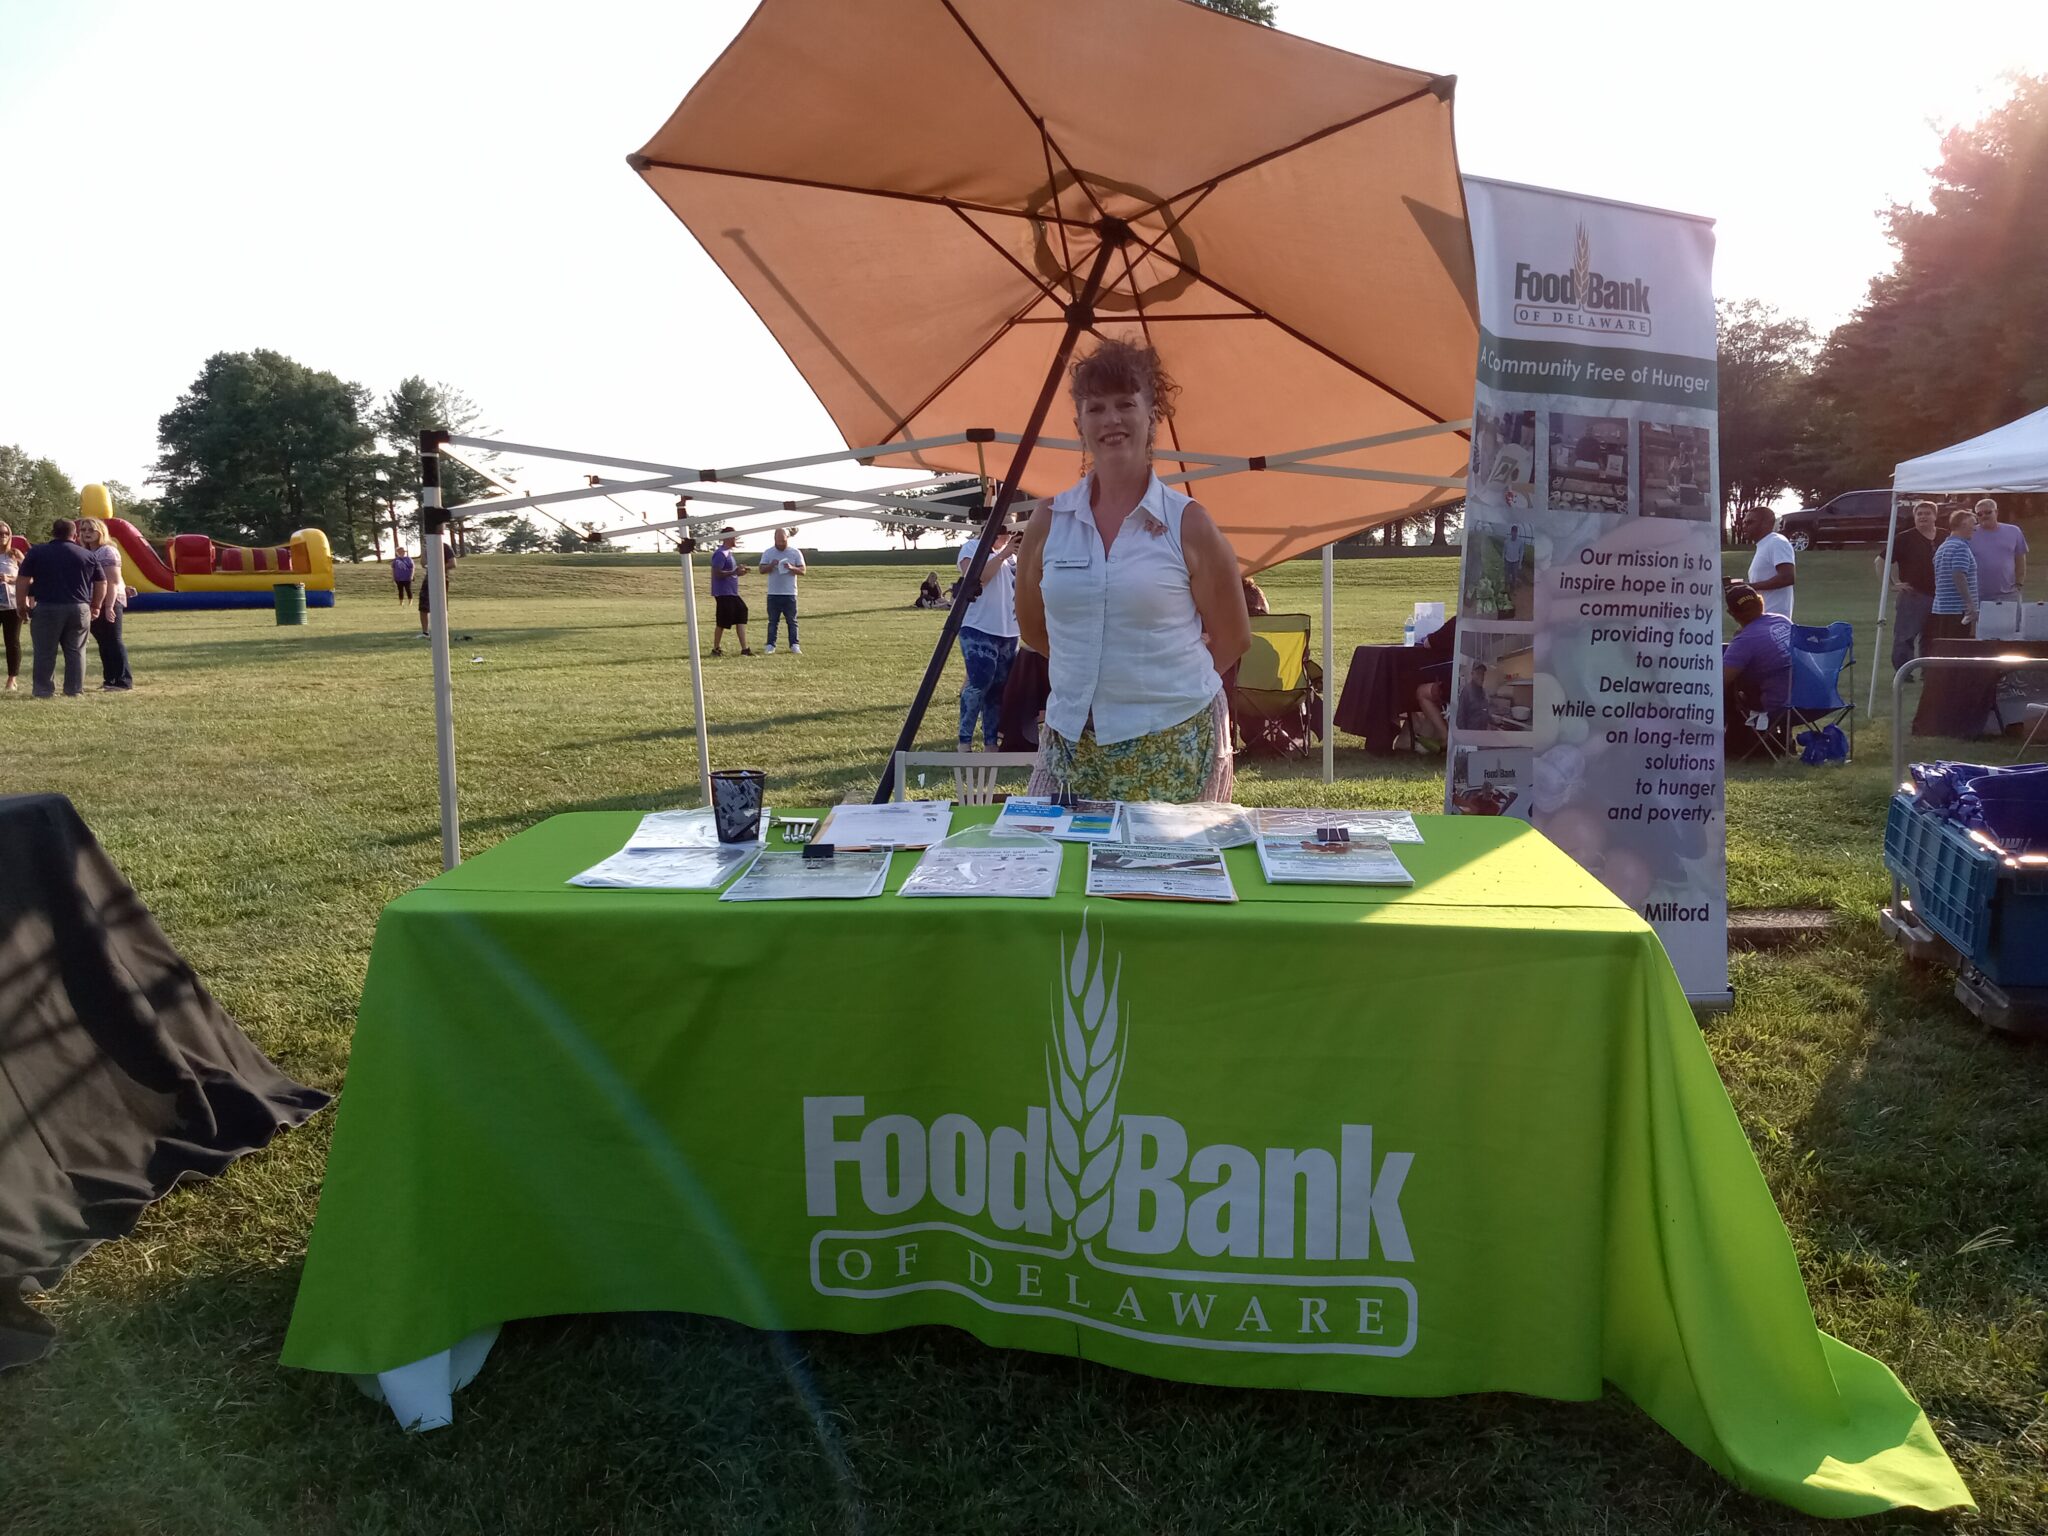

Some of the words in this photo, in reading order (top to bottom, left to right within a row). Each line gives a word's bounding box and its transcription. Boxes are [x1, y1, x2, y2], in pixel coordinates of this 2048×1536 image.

[1514, 262, 1576, 304] Food
[1587, 273, 1650, 313] Bank
[1520, 309, 1540, 322] OF
[1553, 312, 1647, 333] DELAWARE
[1481, 346, 1487, 364] A
[1488, 350, 1582, 382] Community
[1586, 362, 1626, 382] Free
[1632, 366, 1648, 384] of
[1652, 369, 1710, 395] Hunger
[1580, 549, 1612, 568] Our
[1616, 551, 1679, 569] mission
[1682, 553, 1695, 570] is
[1698, 555, 1712, 572] to
[1559, 572, 1616, 595] inspire
[1621, 575, 1666, 597] hope
[1671, 578, 1685, 595] in
[1689, 582, 1713, 597] our
[1579, 599, 1690, 621] communities
[1695, 604, 1712, 624] by
[1591, 625, 1674, 648] providing
[1678, 628, 1714, 645] food
[1636, 653, 1653, 669] to
[1657, 652, 1714, 671] nourish
[1599, 676, 1714, 697] Delawareans,
[1552, 701, 1596, 719] while
[1602, 702, 1715, 725] collaborating
[1606, 731, 1628, 744] on
[1633, 727, 1715, 751] long-term
[1645, 754, 1715, 771] solutions
[1636, 779, 1654, 795] to
[1658, 779, 1716, 800] hunger
[1607, 804, 1643, 821] and
[1648, 806, 1715, 824] poverty.
[1644, 903, 1710, 922] Milford
[803, 1095, 1053, 1236] Food
[1107, 1114, 1415, 1262] Bank
[837, 1243, 919, 1281] OF
[968, 1249, 1385, 1335] DELAWARE
